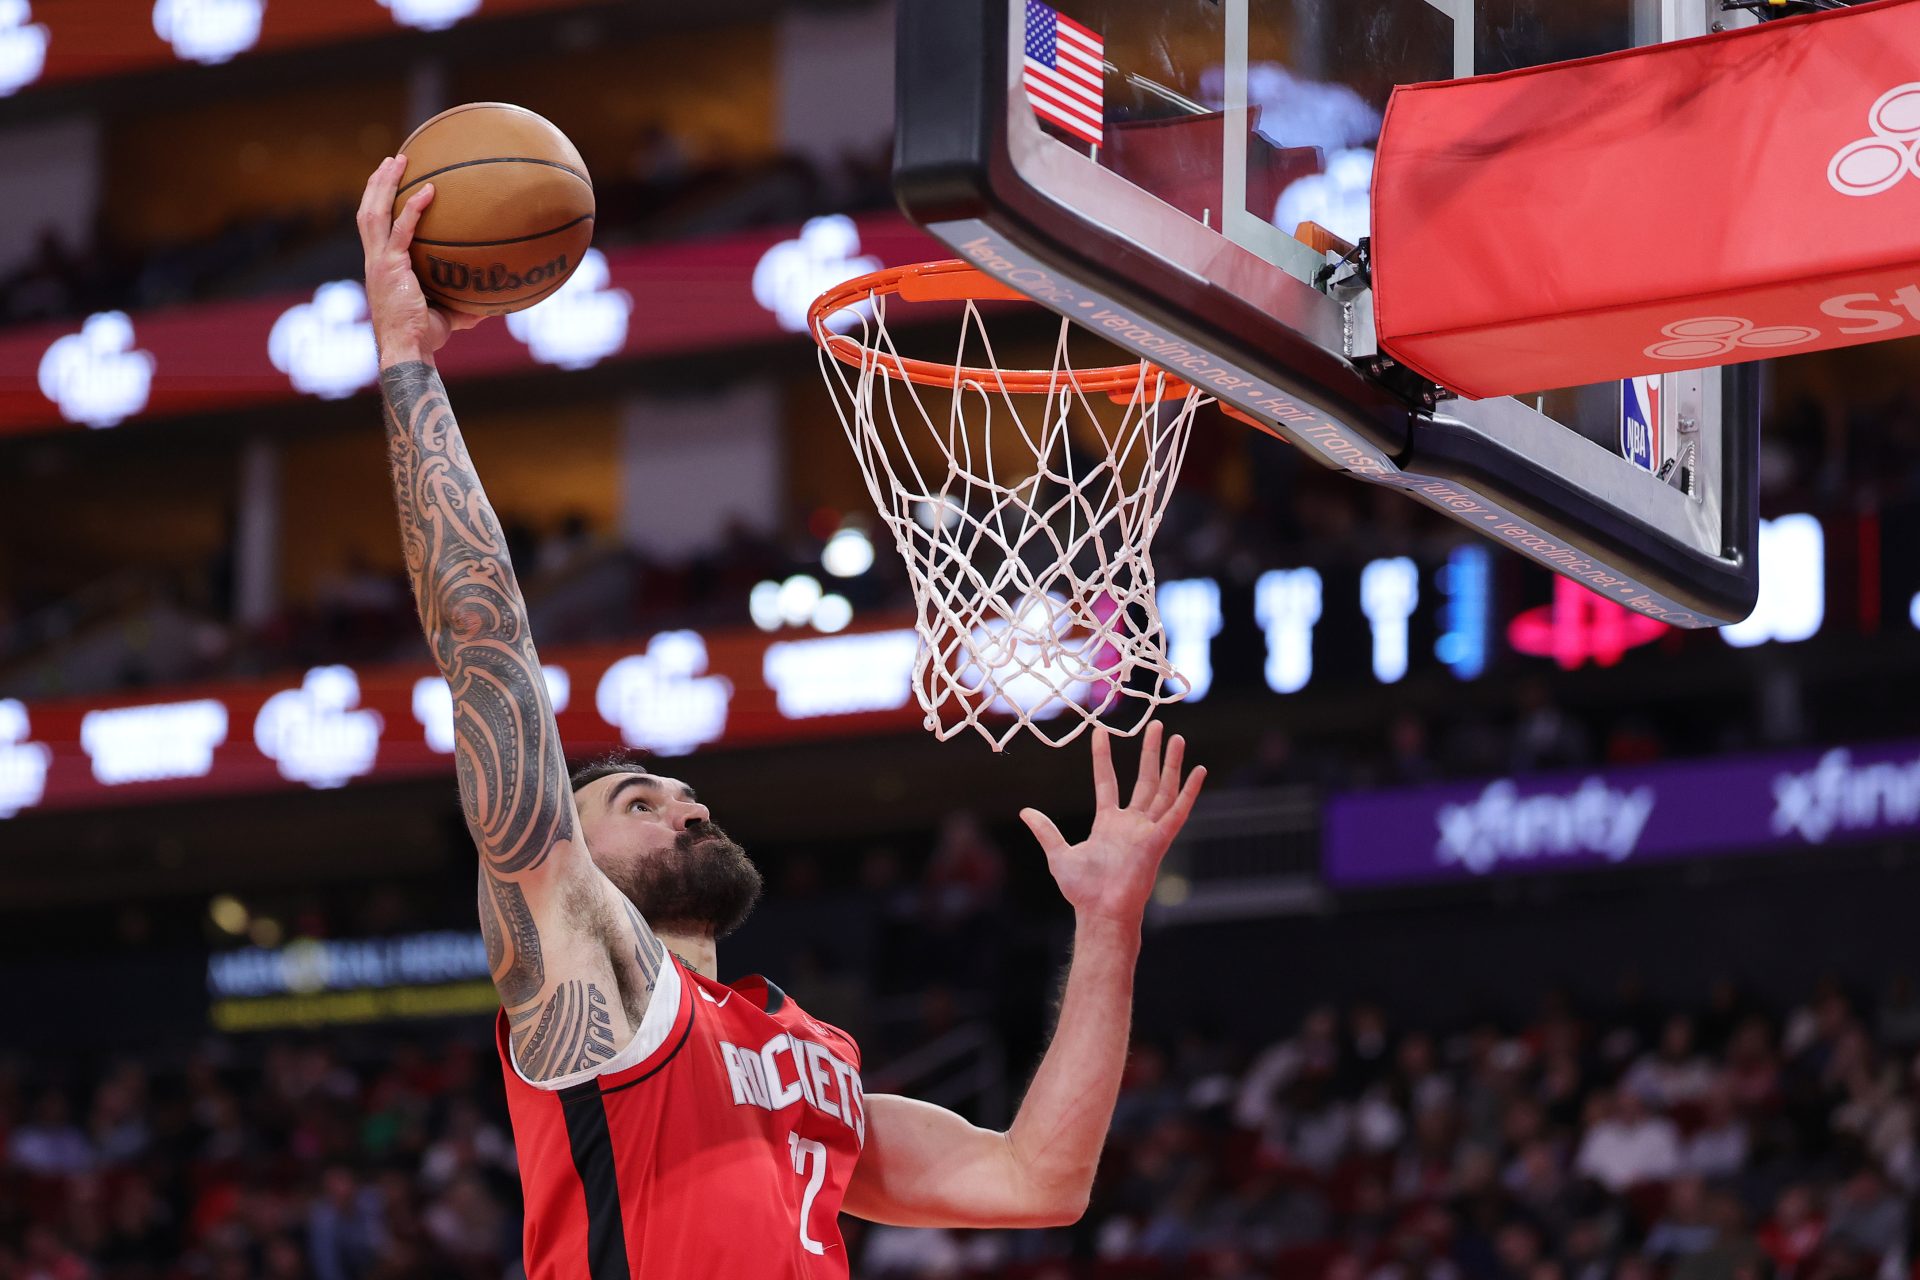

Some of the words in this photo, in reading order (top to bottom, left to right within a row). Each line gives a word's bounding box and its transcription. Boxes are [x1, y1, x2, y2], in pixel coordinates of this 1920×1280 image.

[426, 254, 568, 294] Wilson
[1091, 309, 1254, 391] veraclinic.net
[1255, 397, 1316, 422] Hair
[1493, 522, 1629, 588] veraclinic.net
[1627, 416, 1646, 458] NBA
[718, 1031, 866, 1152] ROCKETS
